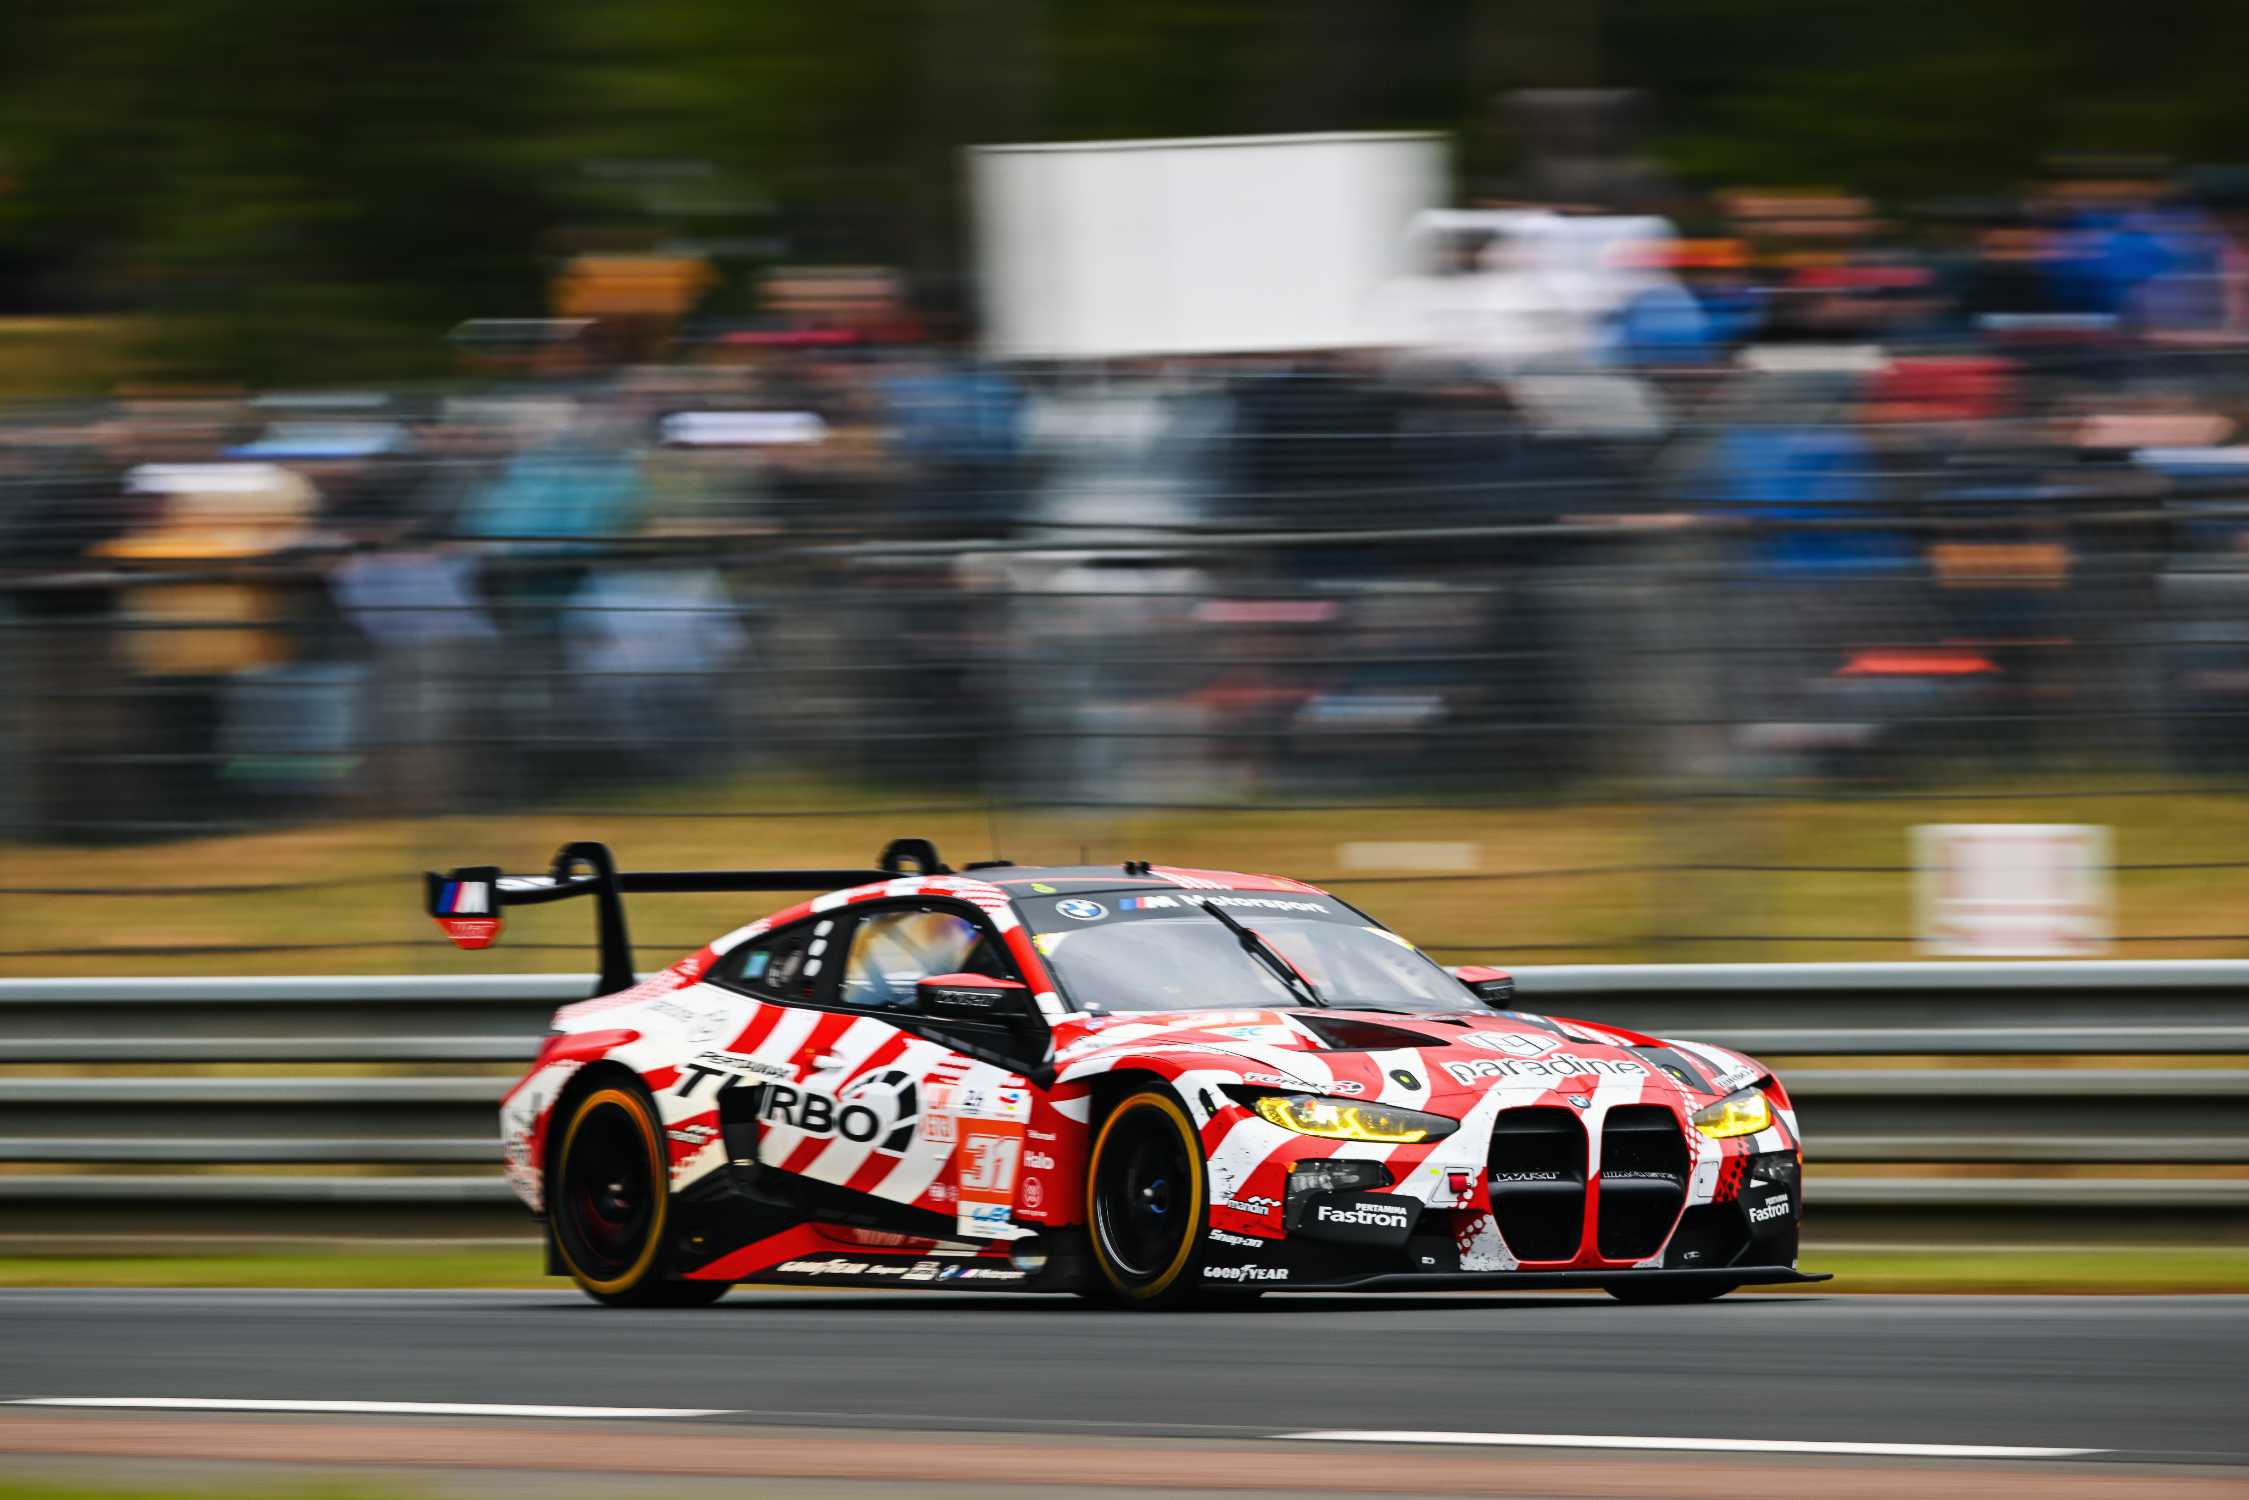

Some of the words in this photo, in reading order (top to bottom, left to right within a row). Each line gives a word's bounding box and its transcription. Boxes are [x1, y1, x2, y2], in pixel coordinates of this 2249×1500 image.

[1178, 895, 1332, 914] Motorsport
[1449, 1055, 1647, 1083] paradine
[960, 1133, 1024, 1194] 31
[1318, 1205, 1407, 1228] Fastron
[1355, 1203, 1407, 1215] PERTAMINA
[1749, 1202, 1789, 1223] Fastron
[1208, 1229, 1264, 1248] Snap-on
[1203, 1264, 1289, 1282] GOODYEAR
